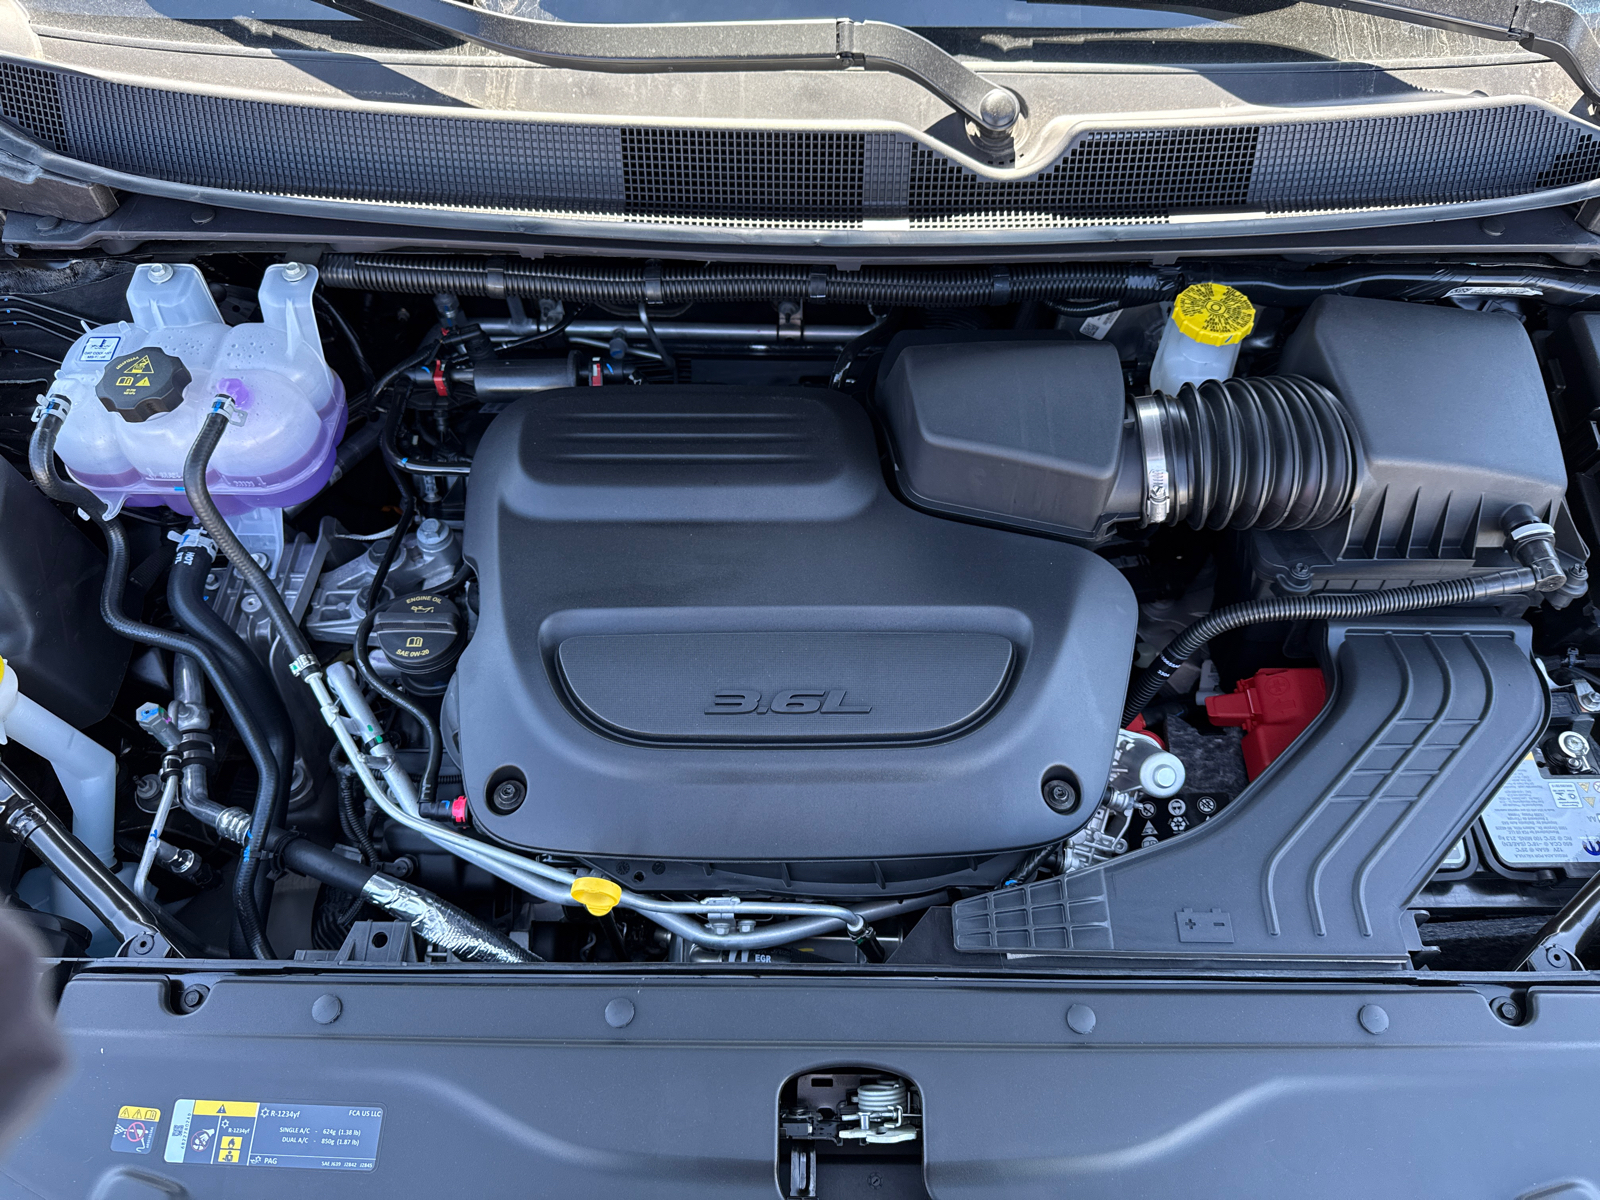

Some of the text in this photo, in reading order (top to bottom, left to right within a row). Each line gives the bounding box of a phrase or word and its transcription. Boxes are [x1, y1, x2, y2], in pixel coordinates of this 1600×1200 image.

[406, 596, 431, 604] ENGINE
[396, 649, 430, 657] SAE 0W-20
[704, 690, 872, 715] 3.6L
[755, 954, 771, 963] EGR
[270, 1110, 300, 1119] R-1234yf
